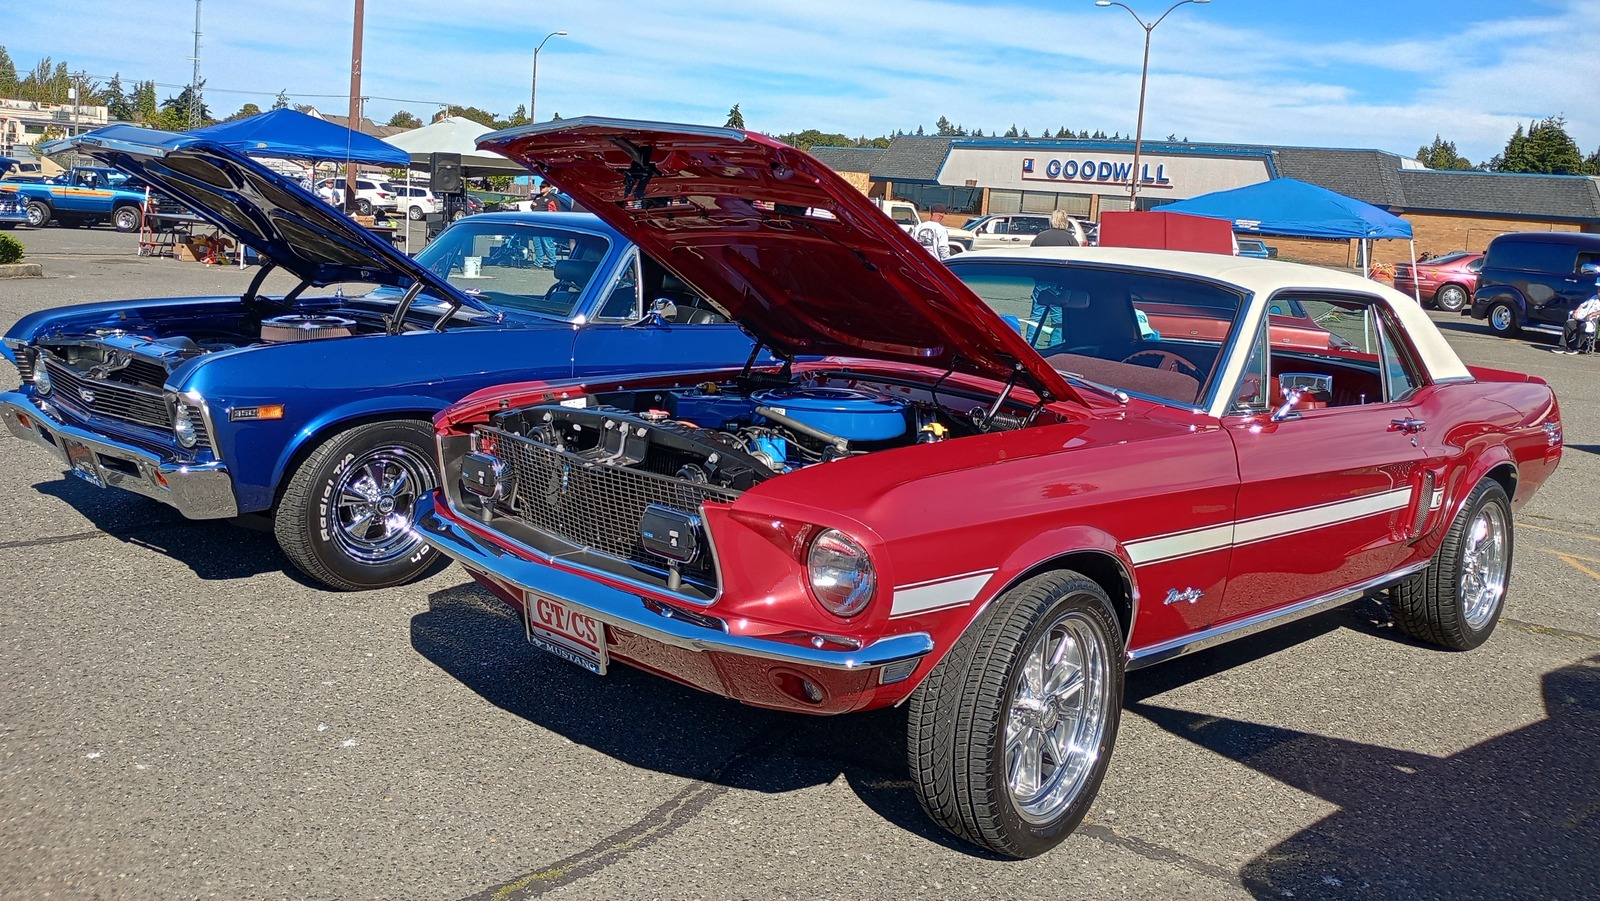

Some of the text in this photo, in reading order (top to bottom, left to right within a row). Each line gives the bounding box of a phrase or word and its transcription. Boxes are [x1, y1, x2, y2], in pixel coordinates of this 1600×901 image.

[333, 453, 355, 475] T/A
[537, 598, 598, 644] GT/CS
[546, 644, 596, 671] MUSTANG
